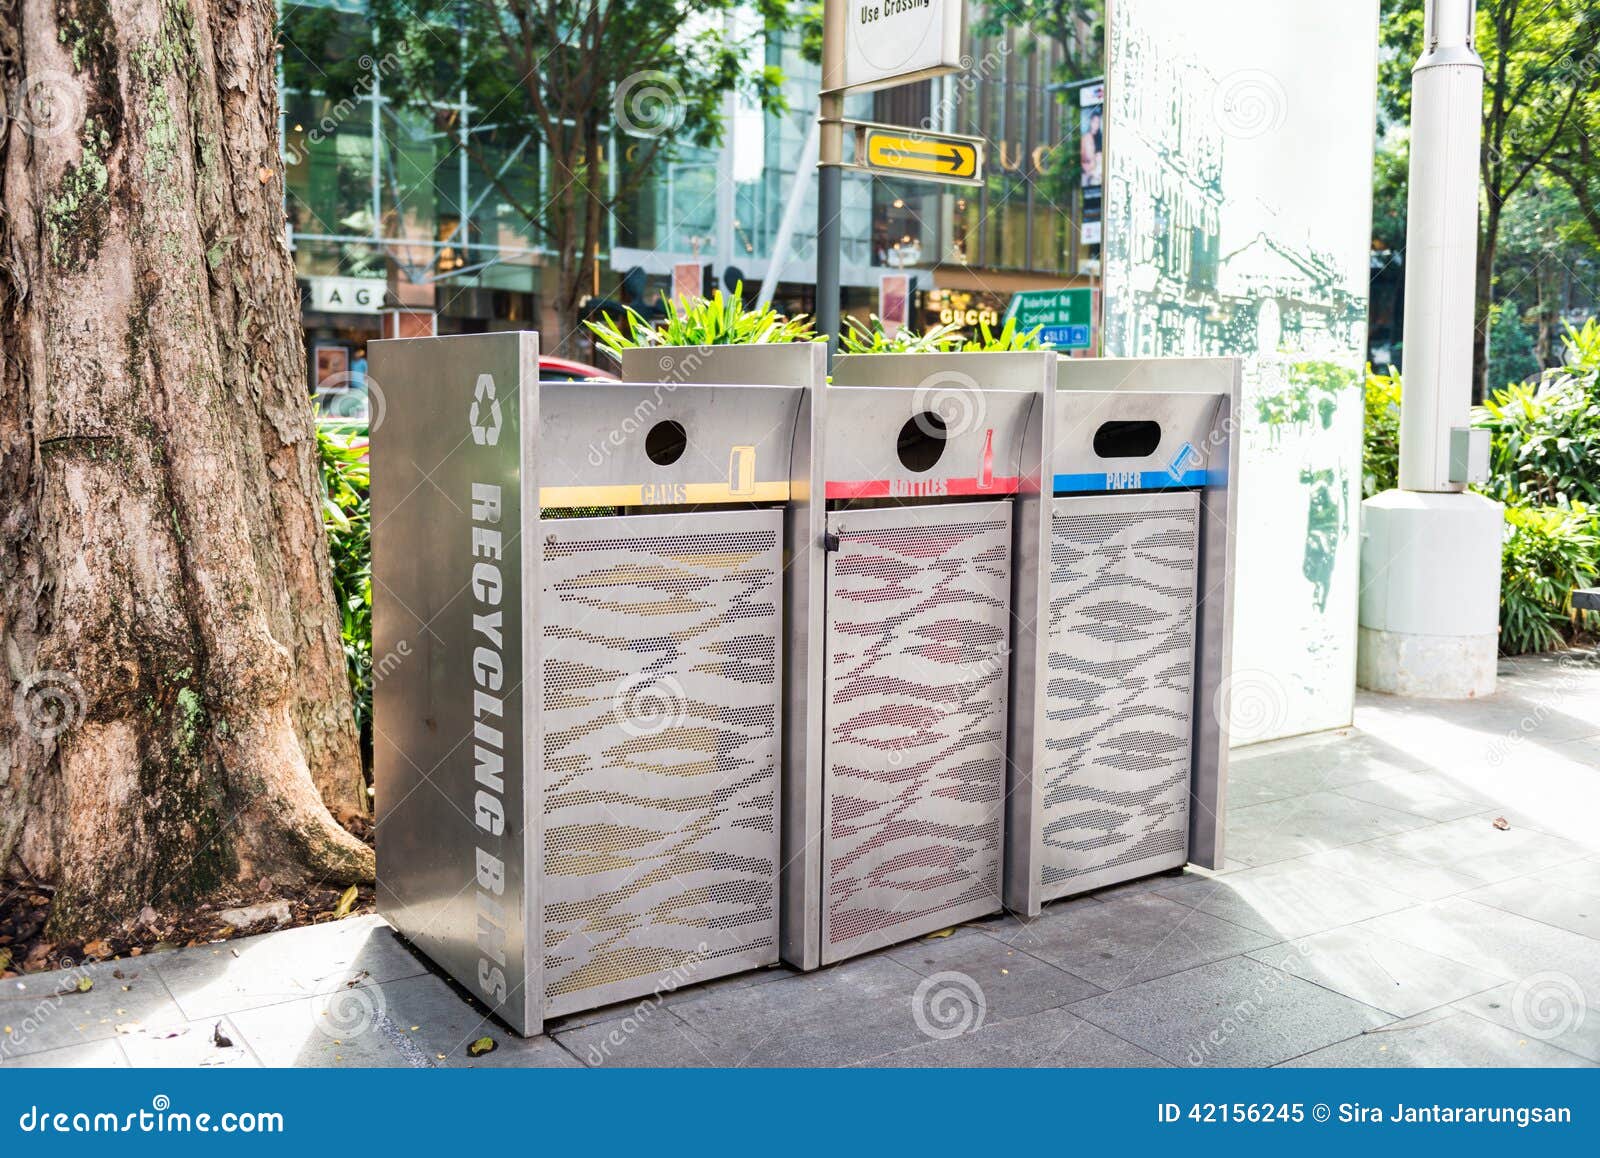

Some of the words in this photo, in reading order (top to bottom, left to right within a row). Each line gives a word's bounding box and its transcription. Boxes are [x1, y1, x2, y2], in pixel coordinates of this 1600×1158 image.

[861, 6, 879, 24] Use
[940, 309, 998, 327] GUCCI
[890, 478, 948, 496] BOTTLES
[1106, 472, 1142, 489] PAPER
[641, 482, 687, 505] CANS
[471, 482, 505, 837] RECYCLING
[476, 846, 507, 1006] BINS
